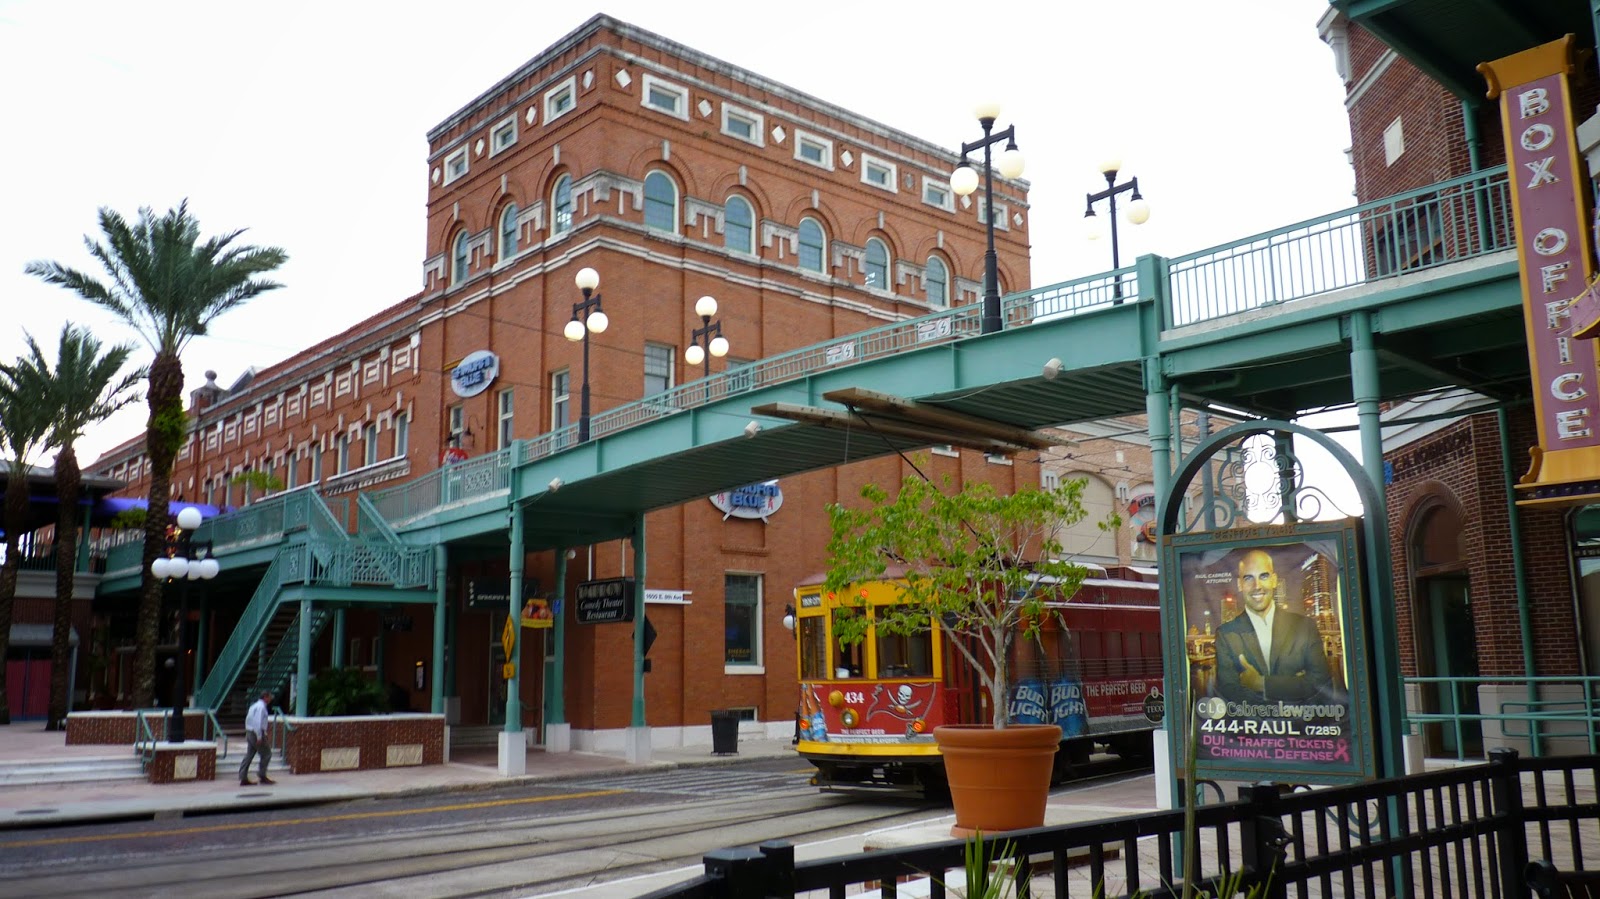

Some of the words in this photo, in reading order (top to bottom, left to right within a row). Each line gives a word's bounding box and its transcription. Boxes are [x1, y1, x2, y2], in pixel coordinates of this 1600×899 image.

[1518, 88, 1559, 189] BOX
[1533, 227, 1593, 440] OFFICE
[731, 492, 766, 508] BLUE
[580, 599, 602, 610] Comedy
[603, 598, 624, 609] Theater
[586, 610, 617, 620] Restaurant
[1016, 686, 1045, 706] BUD
[1051, 685, 1080, 707] BUD
[1086, 685, 1100, 697] THE
[1101, 683, 1129, 696] PERFECT
[1130, 681, 1146, 694] BEER
[844, 692, 865, 704] 434
[1010, 702, 1049, 722] LIGHT
[1146, 704, 1164, 714] TECO
[1198, 702, 1226, 715] CLG
[1201, 719, 1300, 735] 444-RAUL
[1305, 725, 1341, 736] (7285)
[1203, 735, 1225, 746] DUI
[1237, 736, 1286, 748] TRAFFIC
[1287, 737, 1334, 750] TICKETS
[1210, 747, 1272, 759] CRIMINAL
[1274, 750, 1335, 761] DEFENSE
